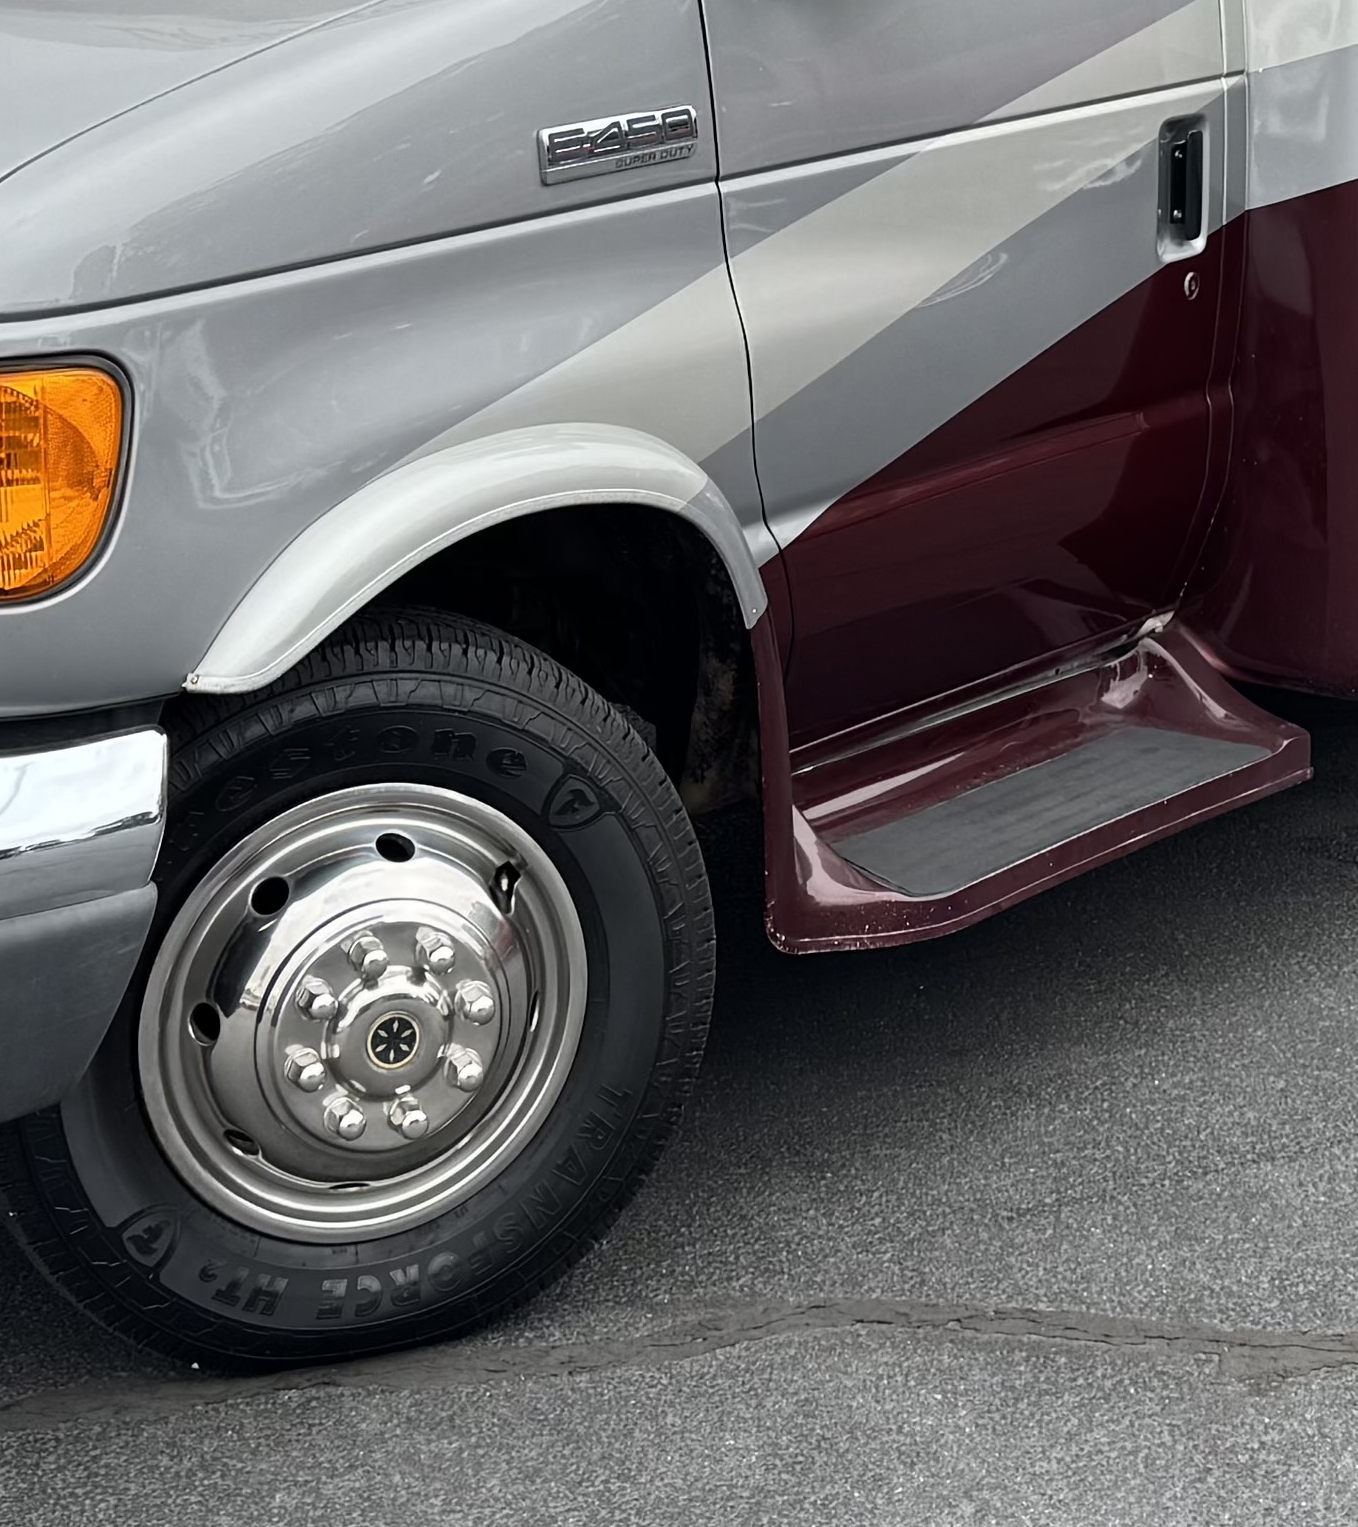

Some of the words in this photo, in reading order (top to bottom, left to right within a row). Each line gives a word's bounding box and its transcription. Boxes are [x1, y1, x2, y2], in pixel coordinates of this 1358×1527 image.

[547, 107, 696, 167] E-450
[615, 151, 657, 169] SUPER
[659, 143, 695, 161] DUTY
[315, 1082, 634, 1322] TRANSFORCE
